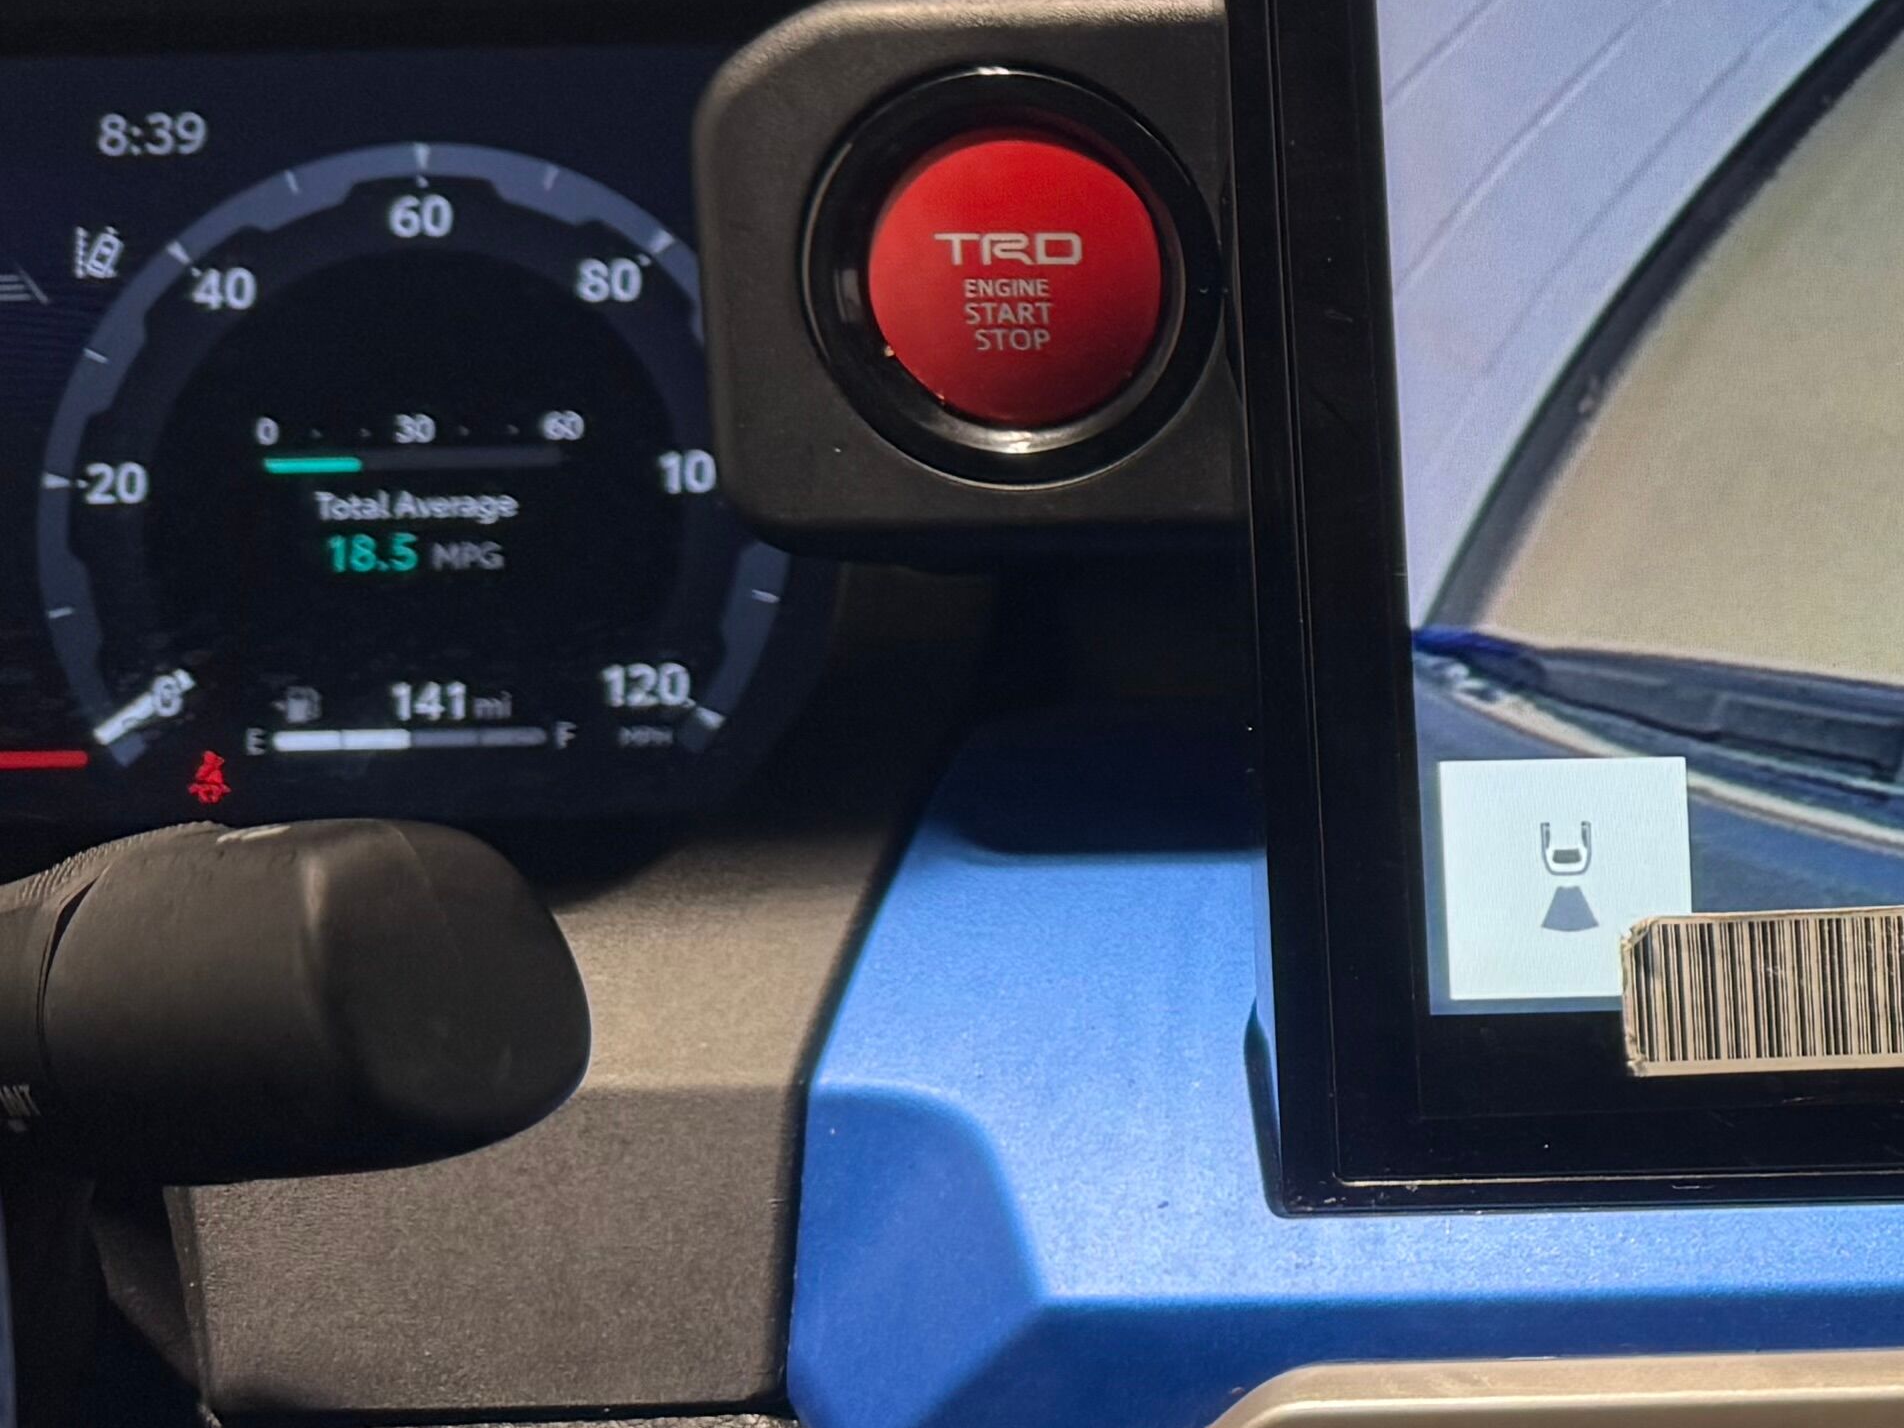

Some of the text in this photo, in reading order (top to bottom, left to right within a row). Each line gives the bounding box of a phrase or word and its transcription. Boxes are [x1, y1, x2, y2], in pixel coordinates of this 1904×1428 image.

[98, 110, 208, 157] 8:39
[388, 194, 453, 239] 60
[935, 233, 1082, 265] TRD
[192, 268, 257, 311] 40
[576, 258, 643, 303] 80
[965, 279, 1049, 297] ENGINE
[966, 304, 1051, 324] START
[976, 330, 1049, 350] STOP
[255, 416, 280, 446] 0
[395, 414, 437, 445] 30
[541, 411, 586, 442] 60
[84, 462, 148, 505] 20
[659, 450, 717, 494] 10
[315, 491, 521, 525] Total Average
[327, 533, 505, 572] 18.5 MPG
[390, 681, 512, 721] 141 mi
[600, 662, 690, 708] 120
